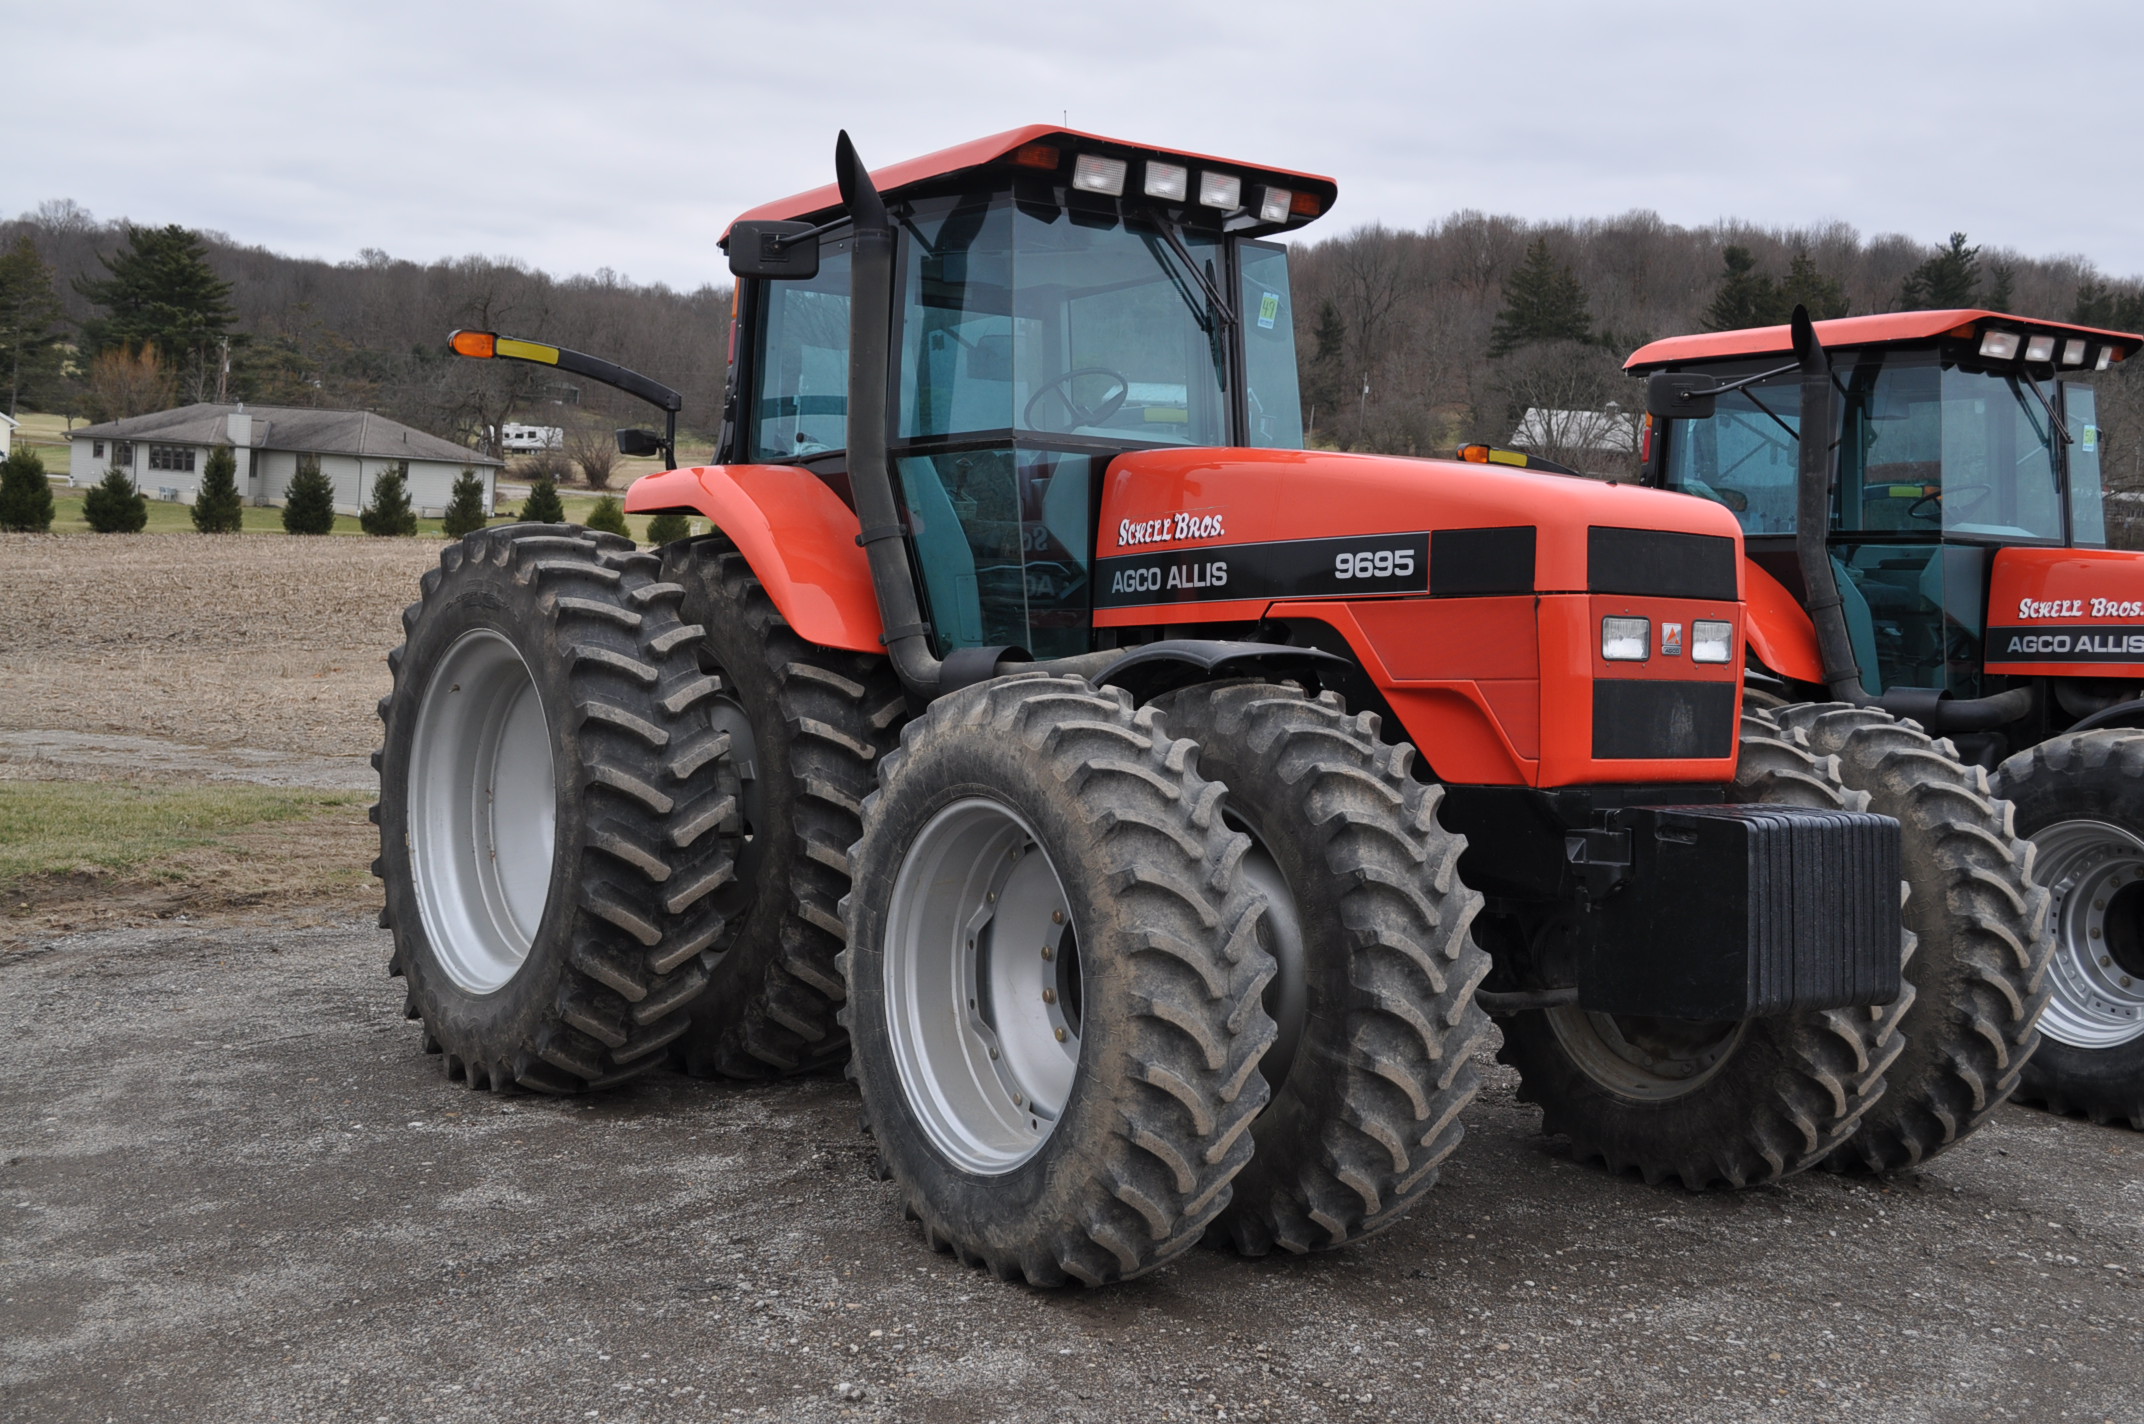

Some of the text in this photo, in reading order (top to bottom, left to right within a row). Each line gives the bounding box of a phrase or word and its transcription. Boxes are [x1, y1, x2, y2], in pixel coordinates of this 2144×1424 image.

[1117, 512, 1226, 547] SCHELL BROS.
[1111, 561, 1228, 594] AGCO ALLIS
[1334, 549, 1415, 579] 9695
[2018, 597, 2083, 620] SCHELL
[2006, 635, 2144, 653] AGCO ALLIS
